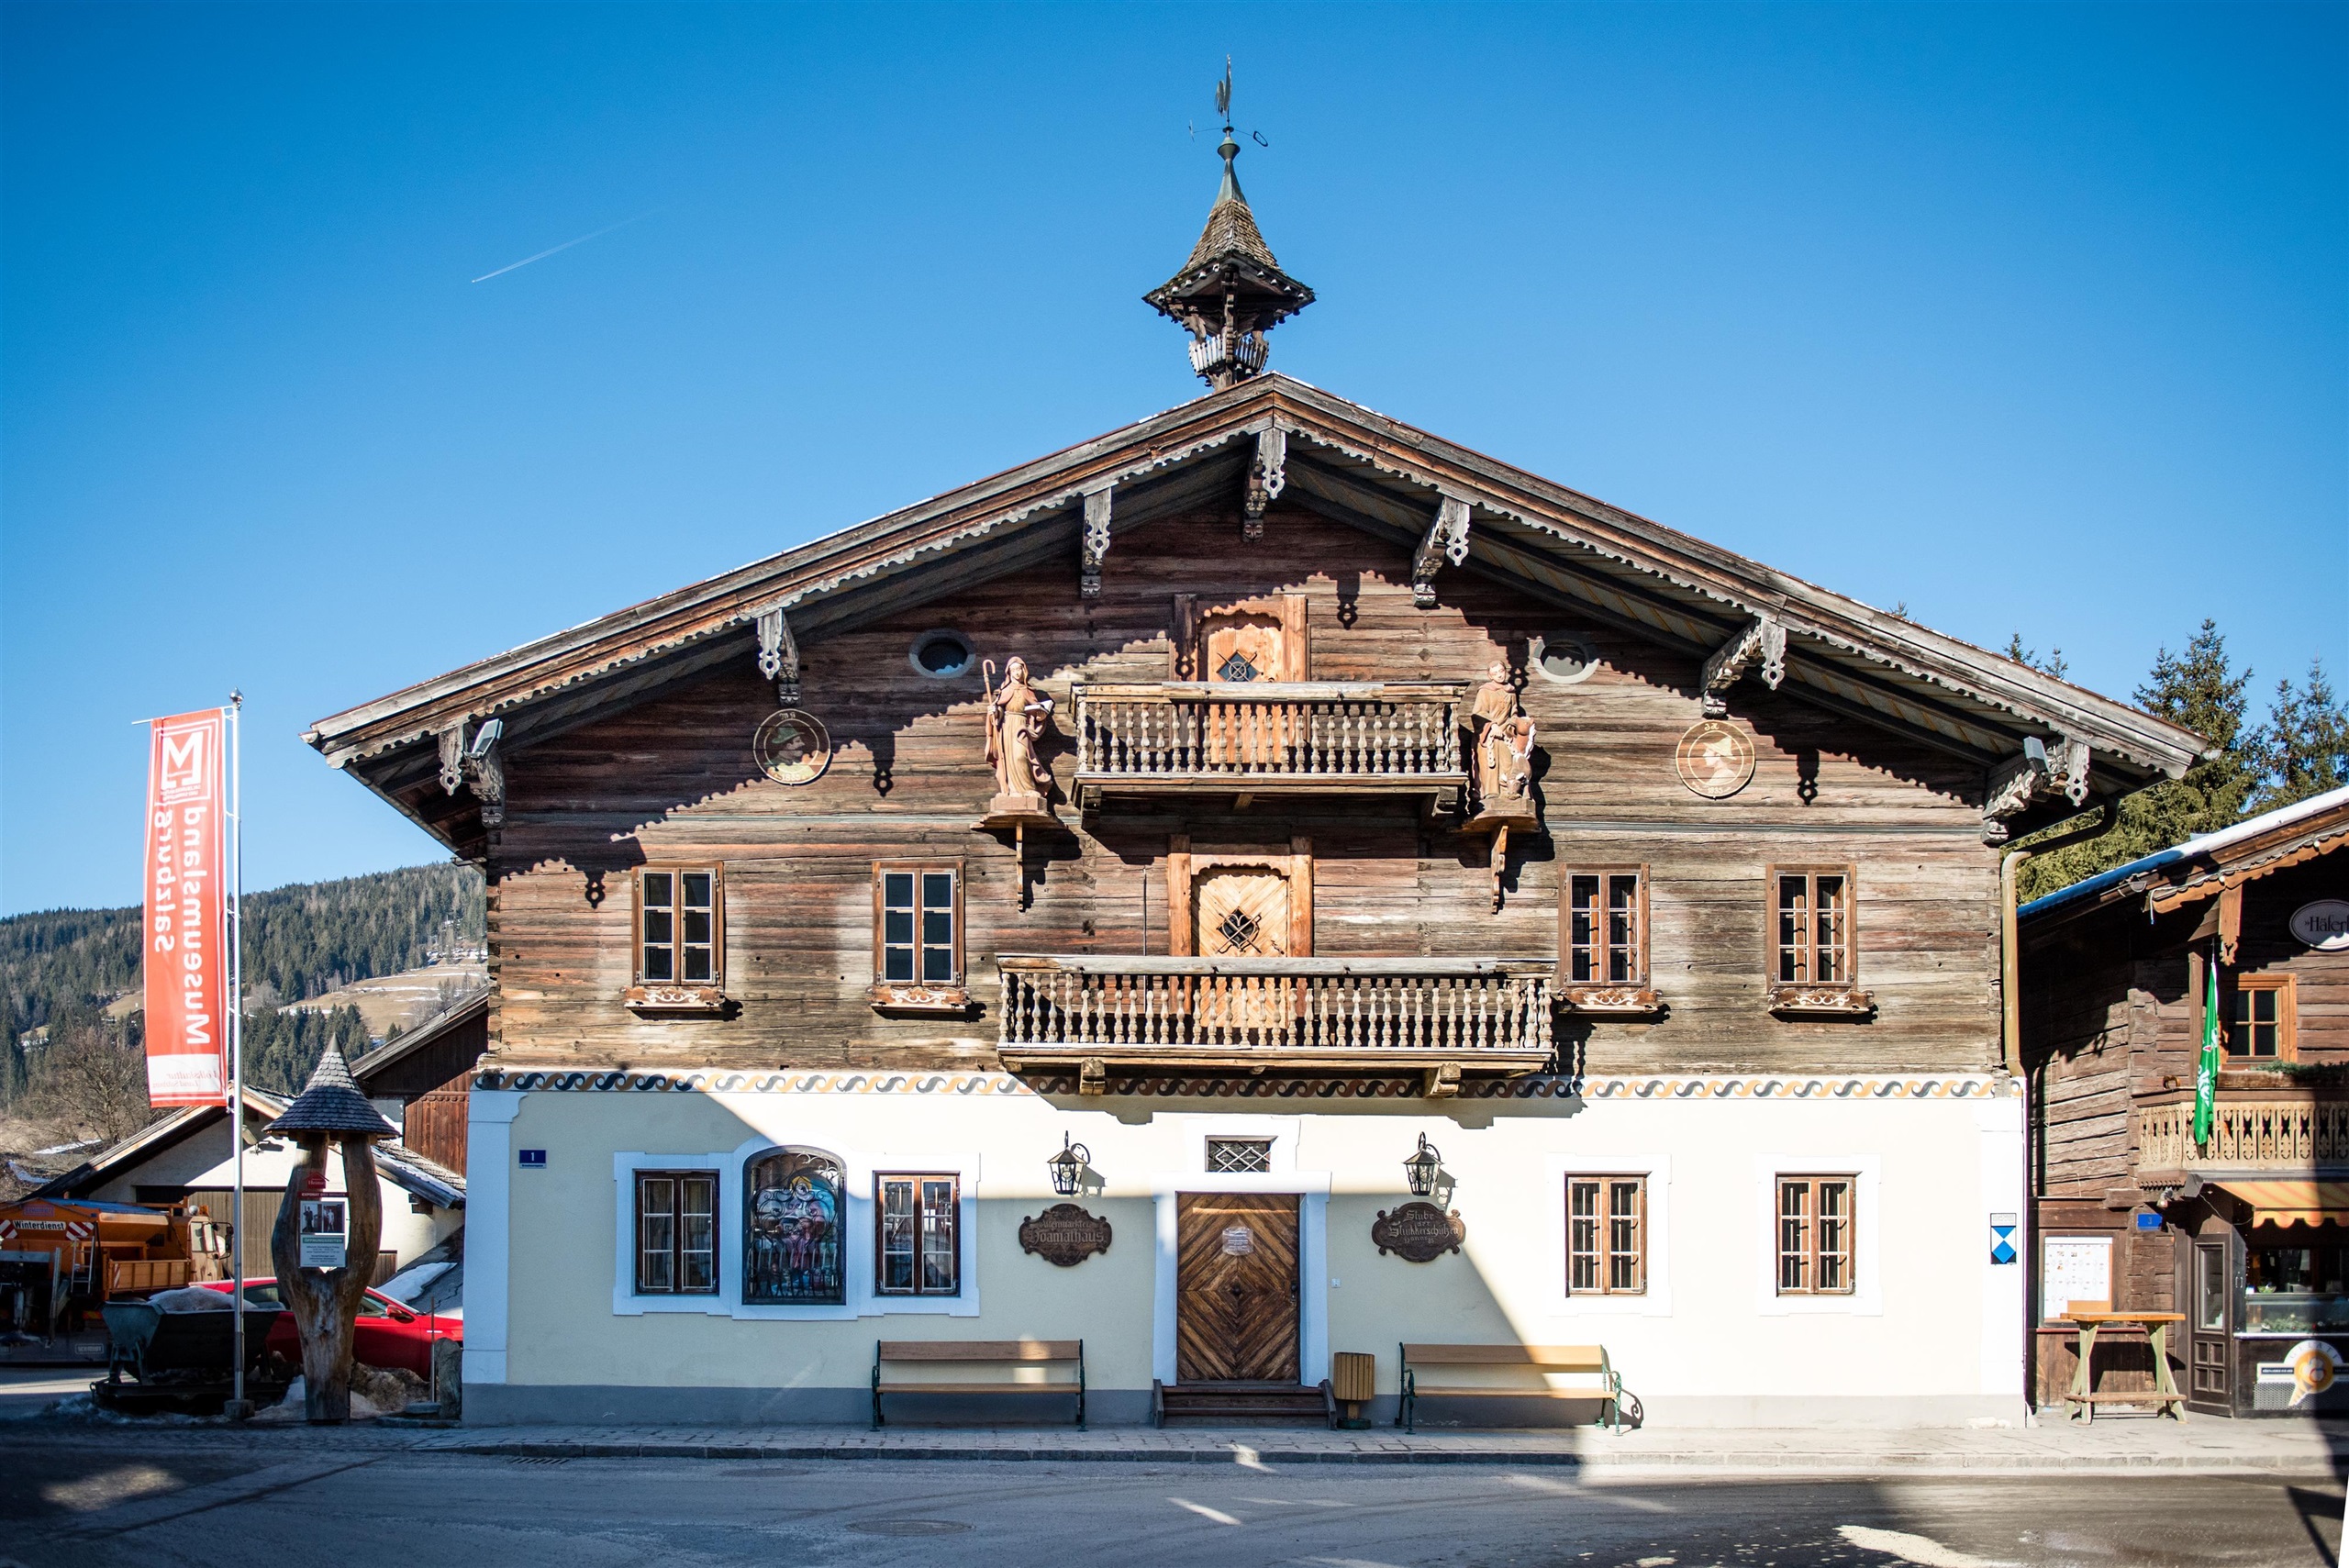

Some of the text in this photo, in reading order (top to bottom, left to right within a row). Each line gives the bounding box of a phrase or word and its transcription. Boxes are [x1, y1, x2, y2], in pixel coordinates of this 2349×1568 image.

[531, 1152, 535, 1162] 1
[14, 1221, 64, 1230] Winterdienst
[1029, 1229, 1104, 1245] Hoamathaus
[2289, 1341, 2338, 1360] GELATI
